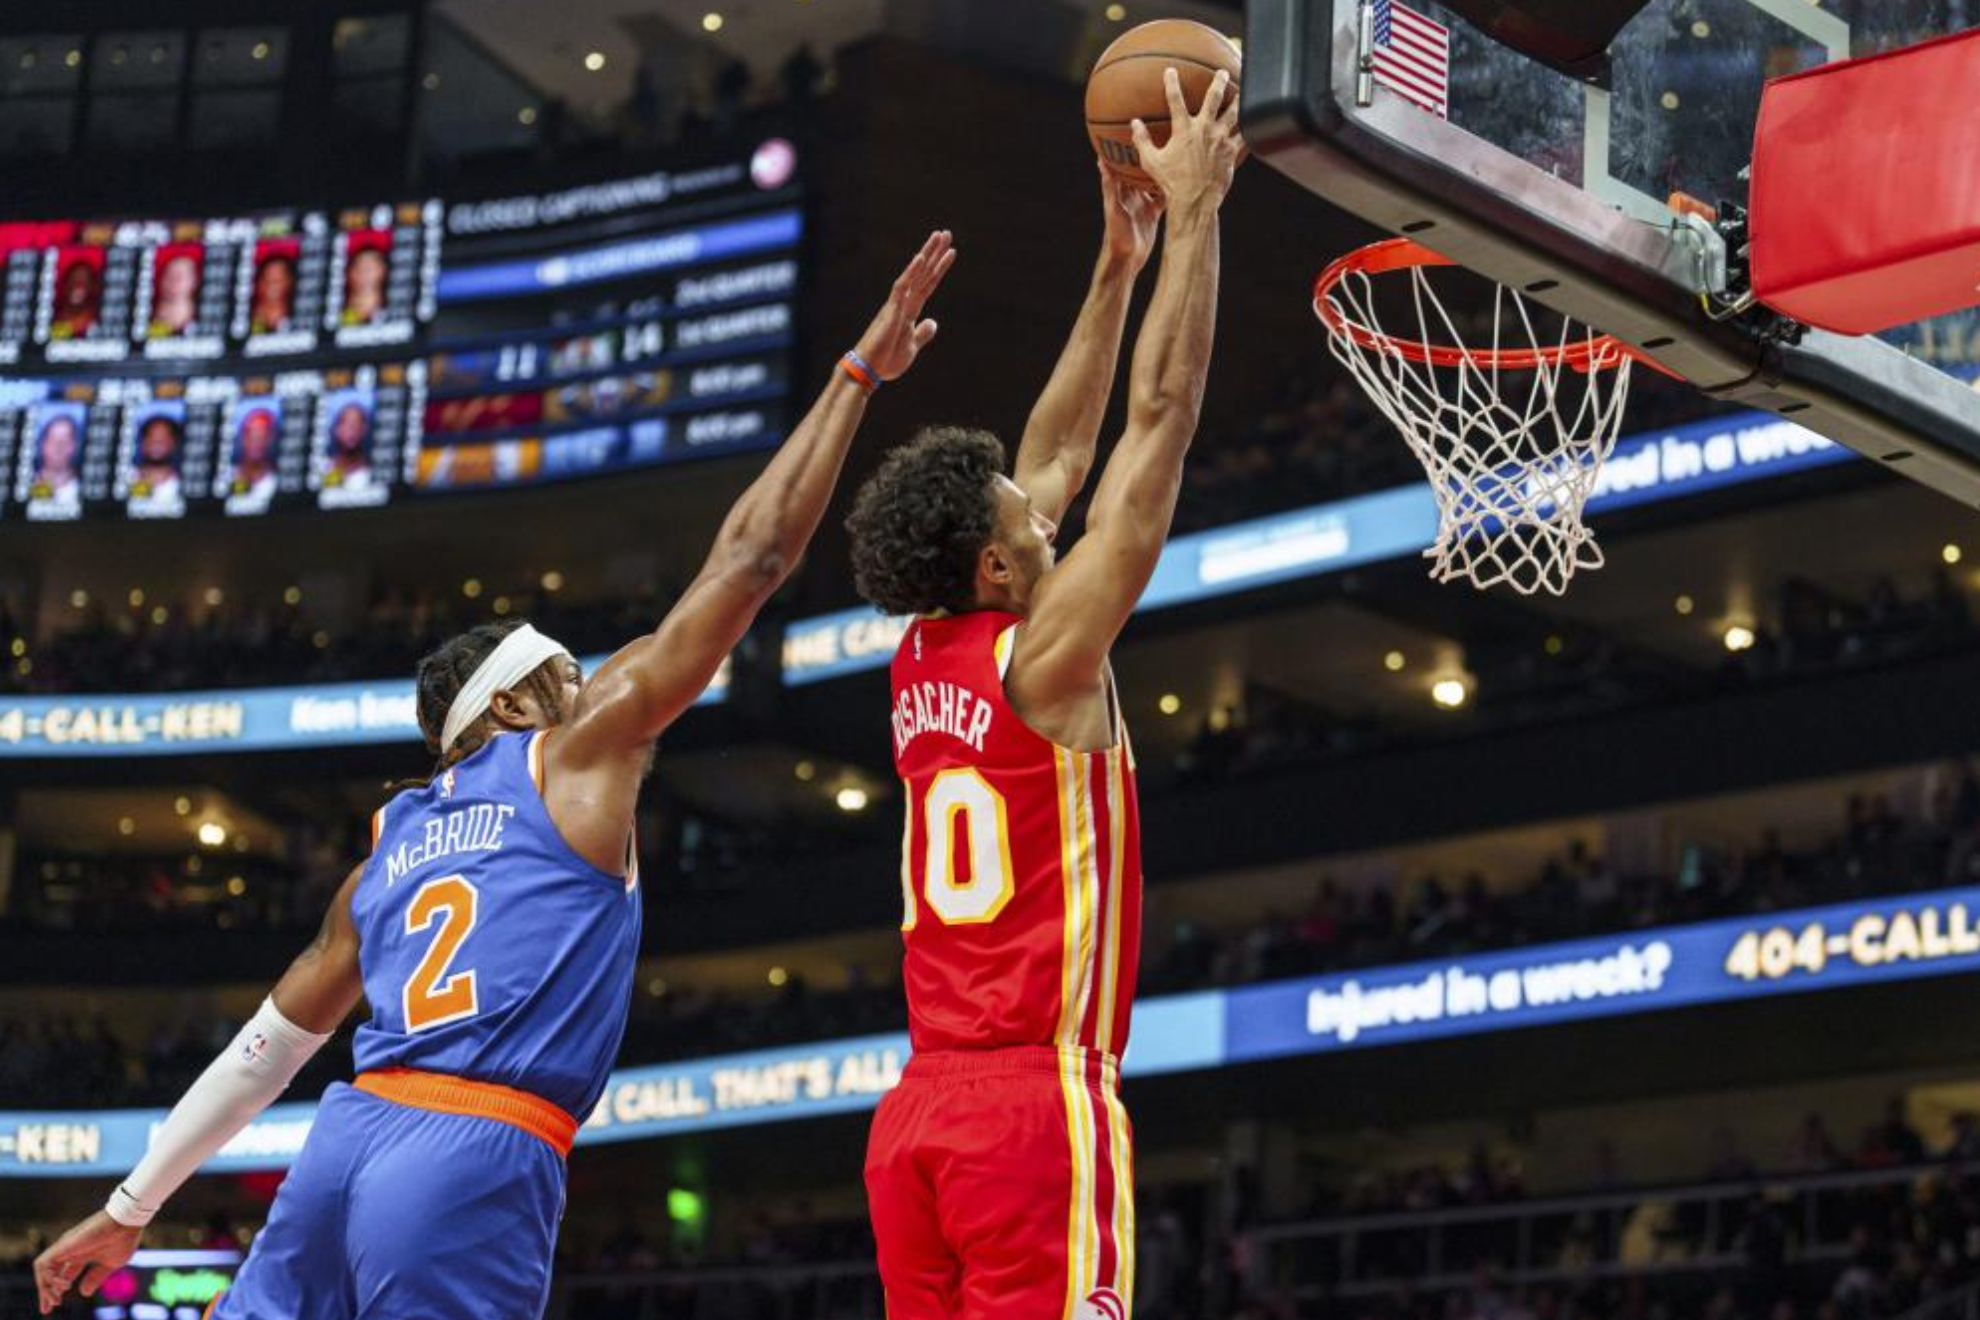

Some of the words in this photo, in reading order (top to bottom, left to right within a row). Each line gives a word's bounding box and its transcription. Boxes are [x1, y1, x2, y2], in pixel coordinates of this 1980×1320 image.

[386, 804, 515, 887] McBRIDE
[403, 873, 479, 1036] 2
[1724, 902, 1980, 981] 404-CALL
[1306, 970, 1445, 1042] Injured
